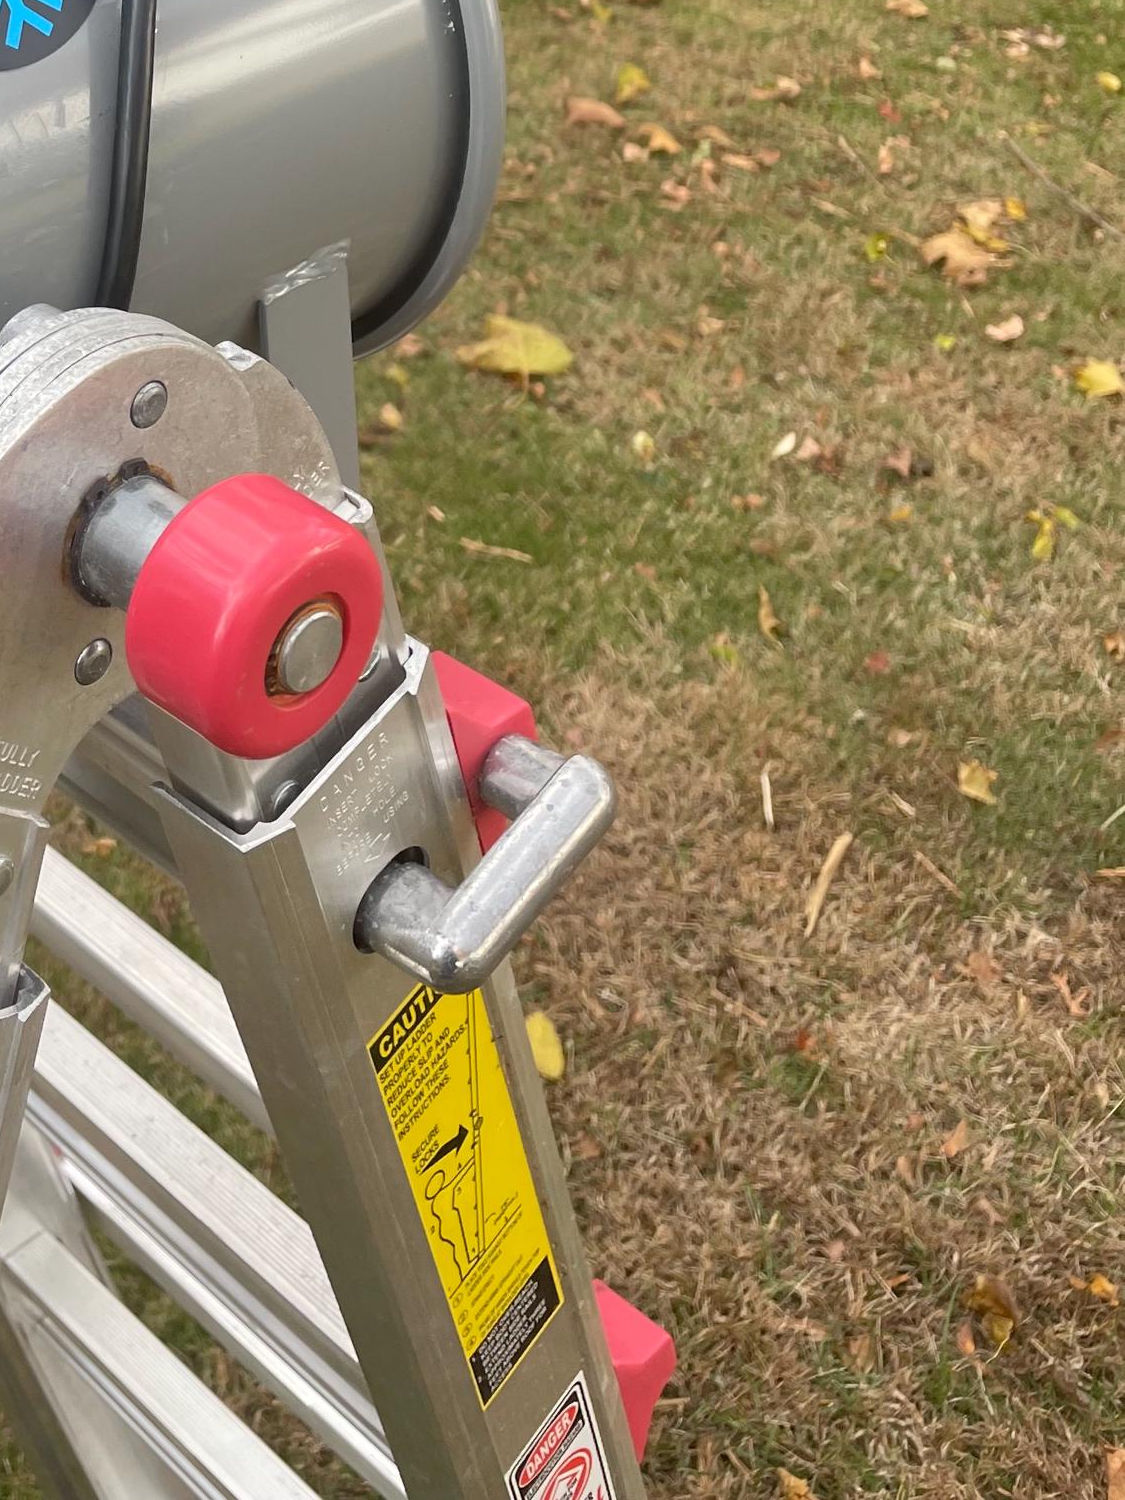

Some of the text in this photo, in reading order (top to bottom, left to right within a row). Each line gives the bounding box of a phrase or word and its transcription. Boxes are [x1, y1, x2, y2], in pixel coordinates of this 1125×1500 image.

[379, 1011, 437, 1084] SET UP LADDER
[383, 1031, 434, 1096] PROPERLY TO
[387, 1026, 451, 1108] REDUCE SLIP AND
[391, 1069, 430, 1119] OVERLOAD
[394, 1059, 450, 1130] FOLLOW THESE
[411, 1124, 440, 1163] SECURE
[415, 1140, 441, 1174] LOCKS
[525, 1412, 572, 1479] DANGER
